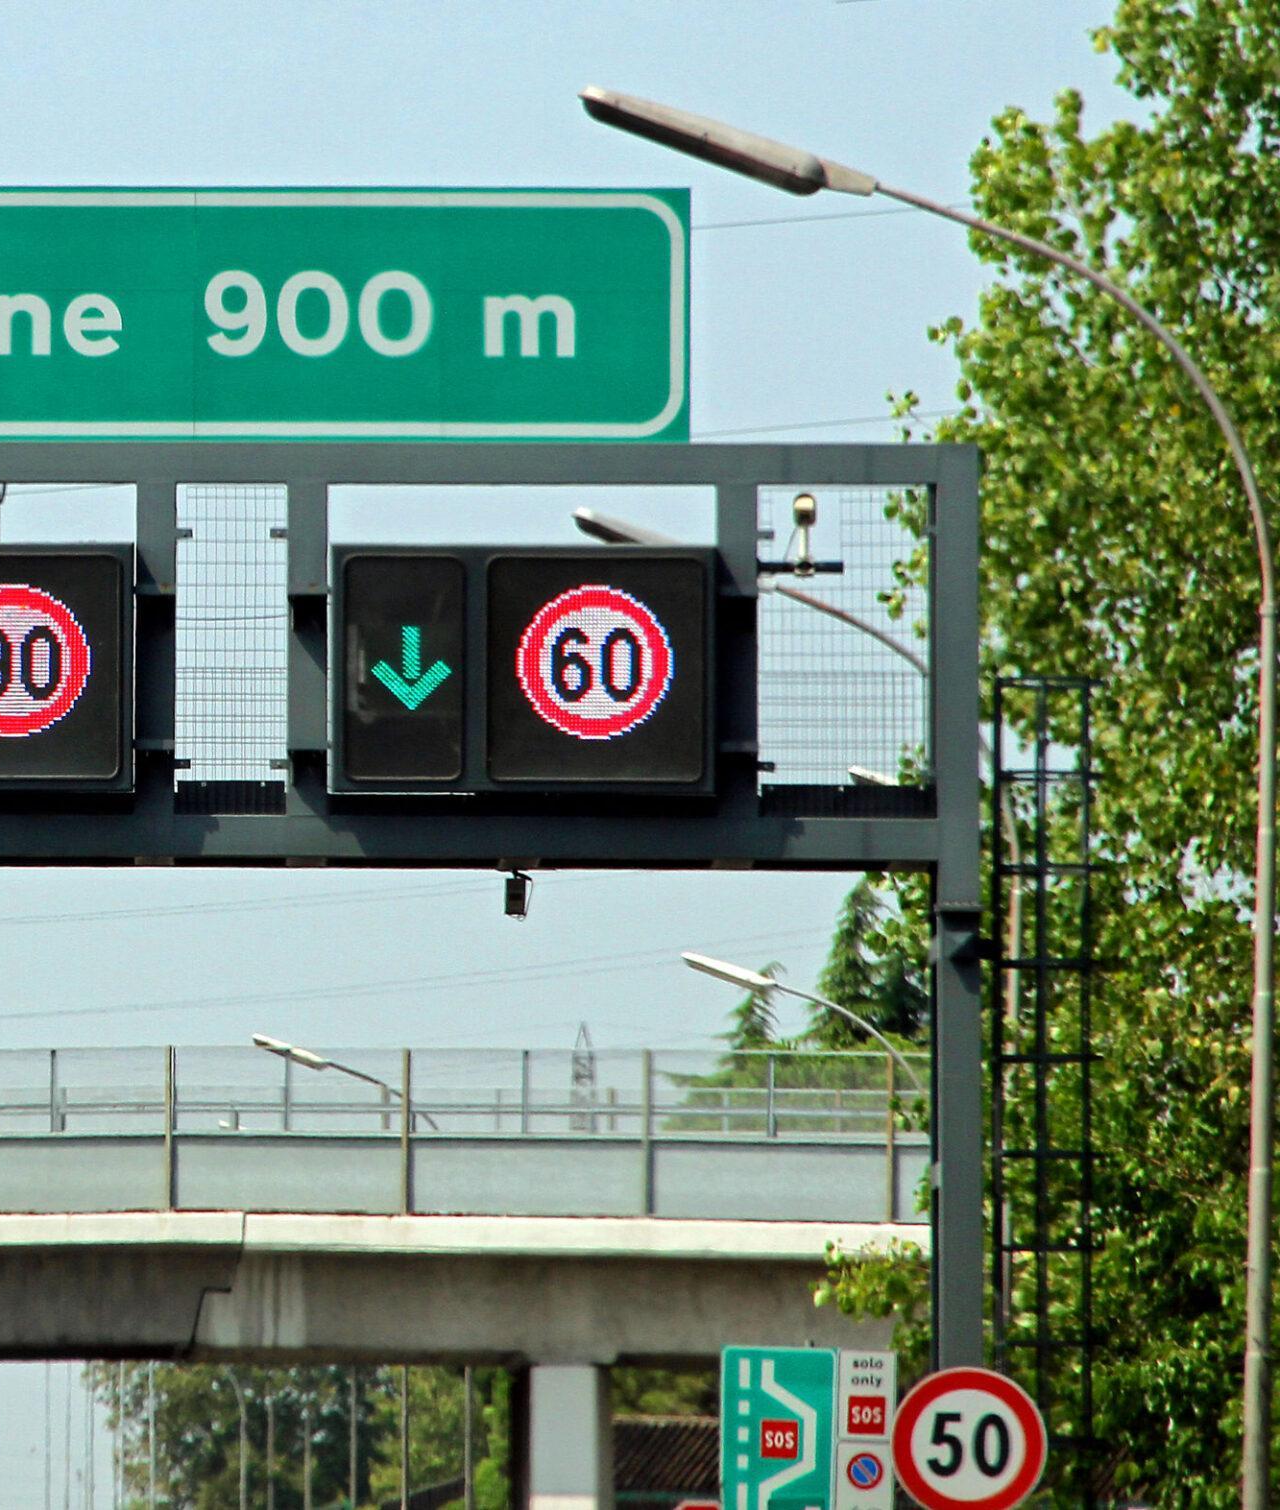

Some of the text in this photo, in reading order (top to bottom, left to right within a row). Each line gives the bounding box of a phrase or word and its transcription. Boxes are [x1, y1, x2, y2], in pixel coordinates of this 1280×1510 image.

[204, 269, 434, 358] 900
[483, 293, 576, 358] m
[550, 626, 643, 703] 60
[852, 1357, 883, 1370] solo
[851, 1374, 882, 1388] only
[851, 1405, 883, 1425] SOS
[764, 1430, 795, 1450] SOS
[926, 1411, 1011, 1478] 50
